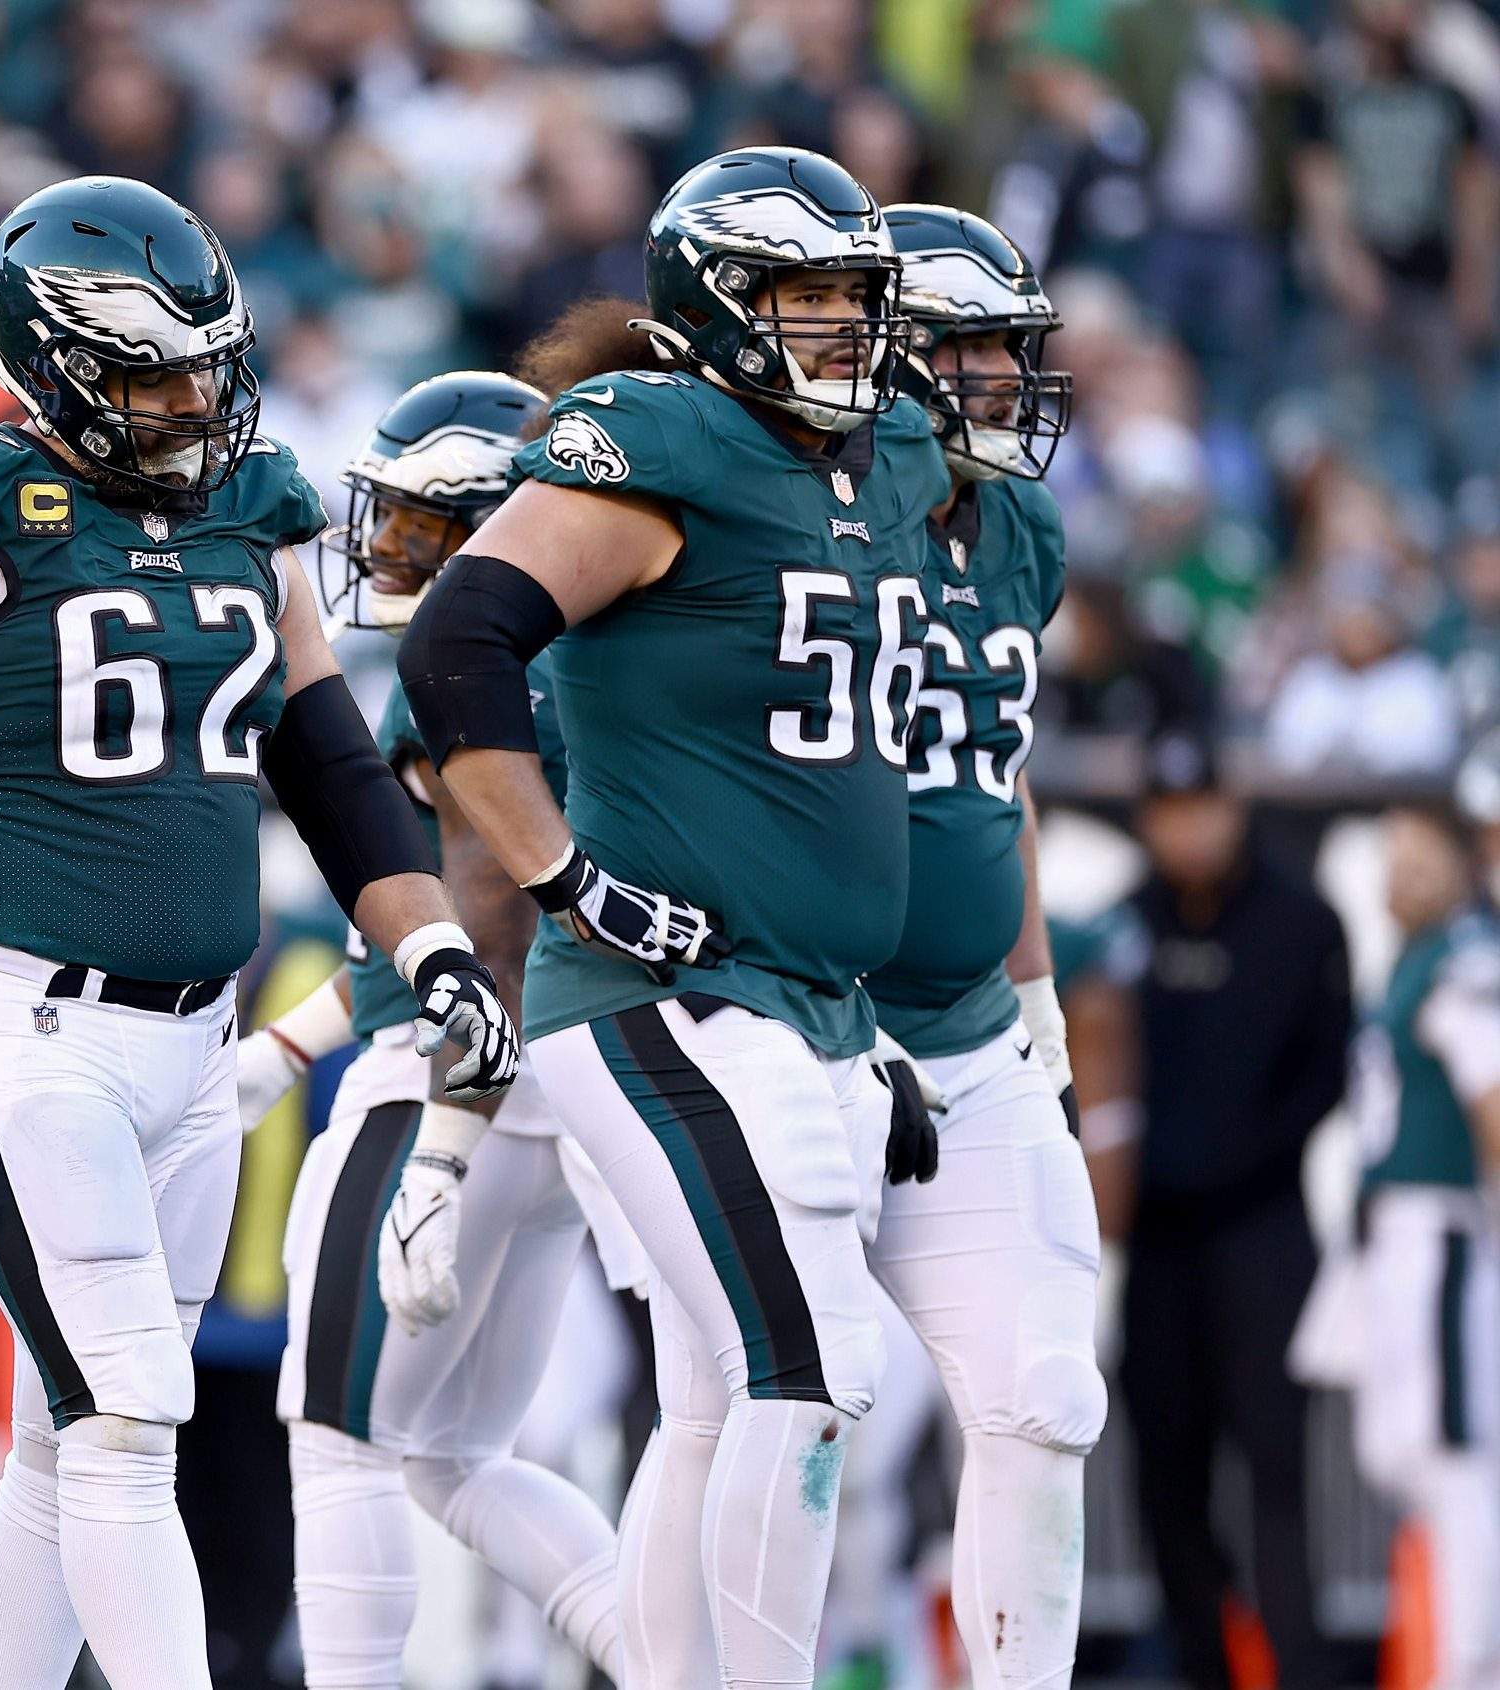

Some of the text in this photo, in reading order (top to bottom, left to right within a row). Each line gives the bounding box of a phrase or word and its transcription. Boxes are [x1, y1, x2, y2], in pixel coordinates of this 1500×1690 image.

[20, 483, 69, 521] C
[829, 518, 871, 543] EAGLES
[127, 550, 184, 574] EAGLES
[55, 585, 277, 779] 62
[768, 570, 928, 767] 56
[905, 621, 1039, 804] 63
[36, 1017, 57, 1031] NFL
